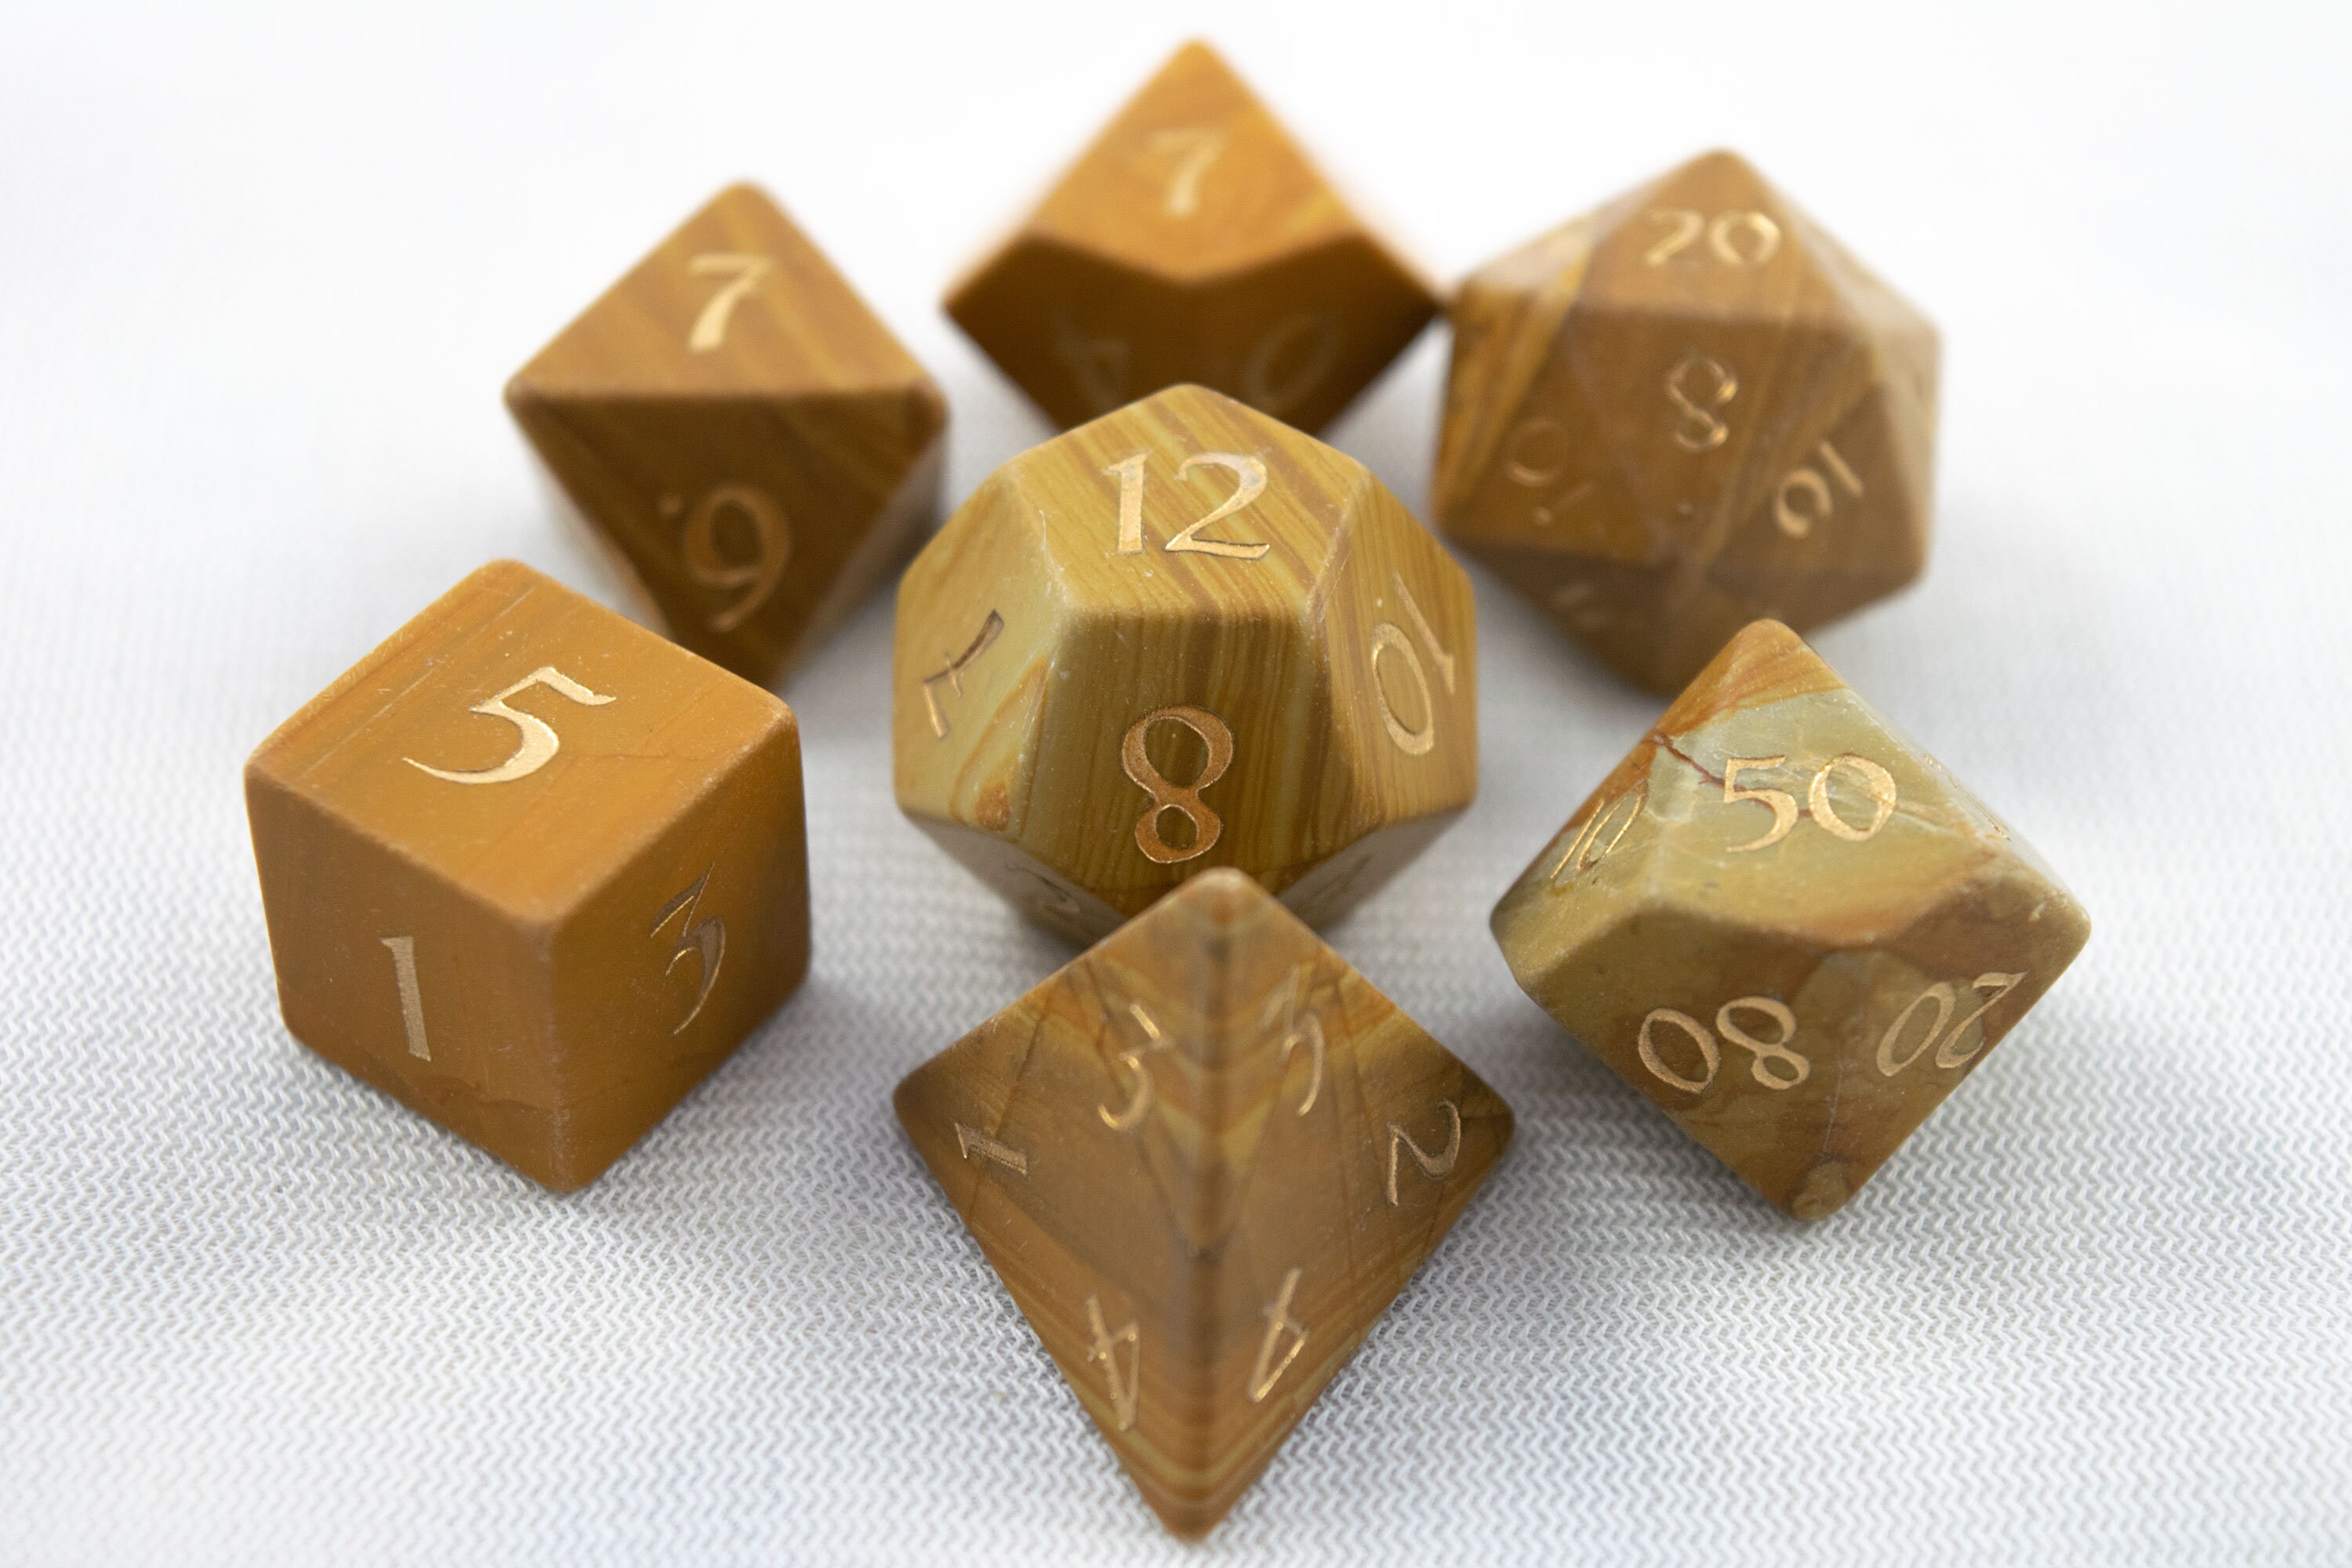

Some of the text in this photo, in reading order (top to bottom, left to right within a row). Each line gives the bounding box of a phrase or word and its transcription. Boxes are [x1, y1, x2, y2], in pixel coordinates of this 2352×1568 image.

[1147, 127, 1228, 218] 7
[1647, 209, 1780, 267] 20
[688, 252, 771, 351] 7
[1105, 452, 1269, 559] 12
[1372, 572, 1454, 755] 10
[402, 666, 616, 784] 5
[1122, 706, 1234, 863] 8
[1549, 780, 1649, 885] 10
[1723, 753, 1896, 852] 50
[380, 936, 431, 1061] 1
[651, 863, 726, 1036] 3
[1877, 971, 2029, 1076] 20
[955, 1122, 1028, 1175] 1
[1386, 1098, 1461, 1206] 2
[1085, 1295, 1139, 1431] 4
[1250, 1268, 1308, 1401] 4
